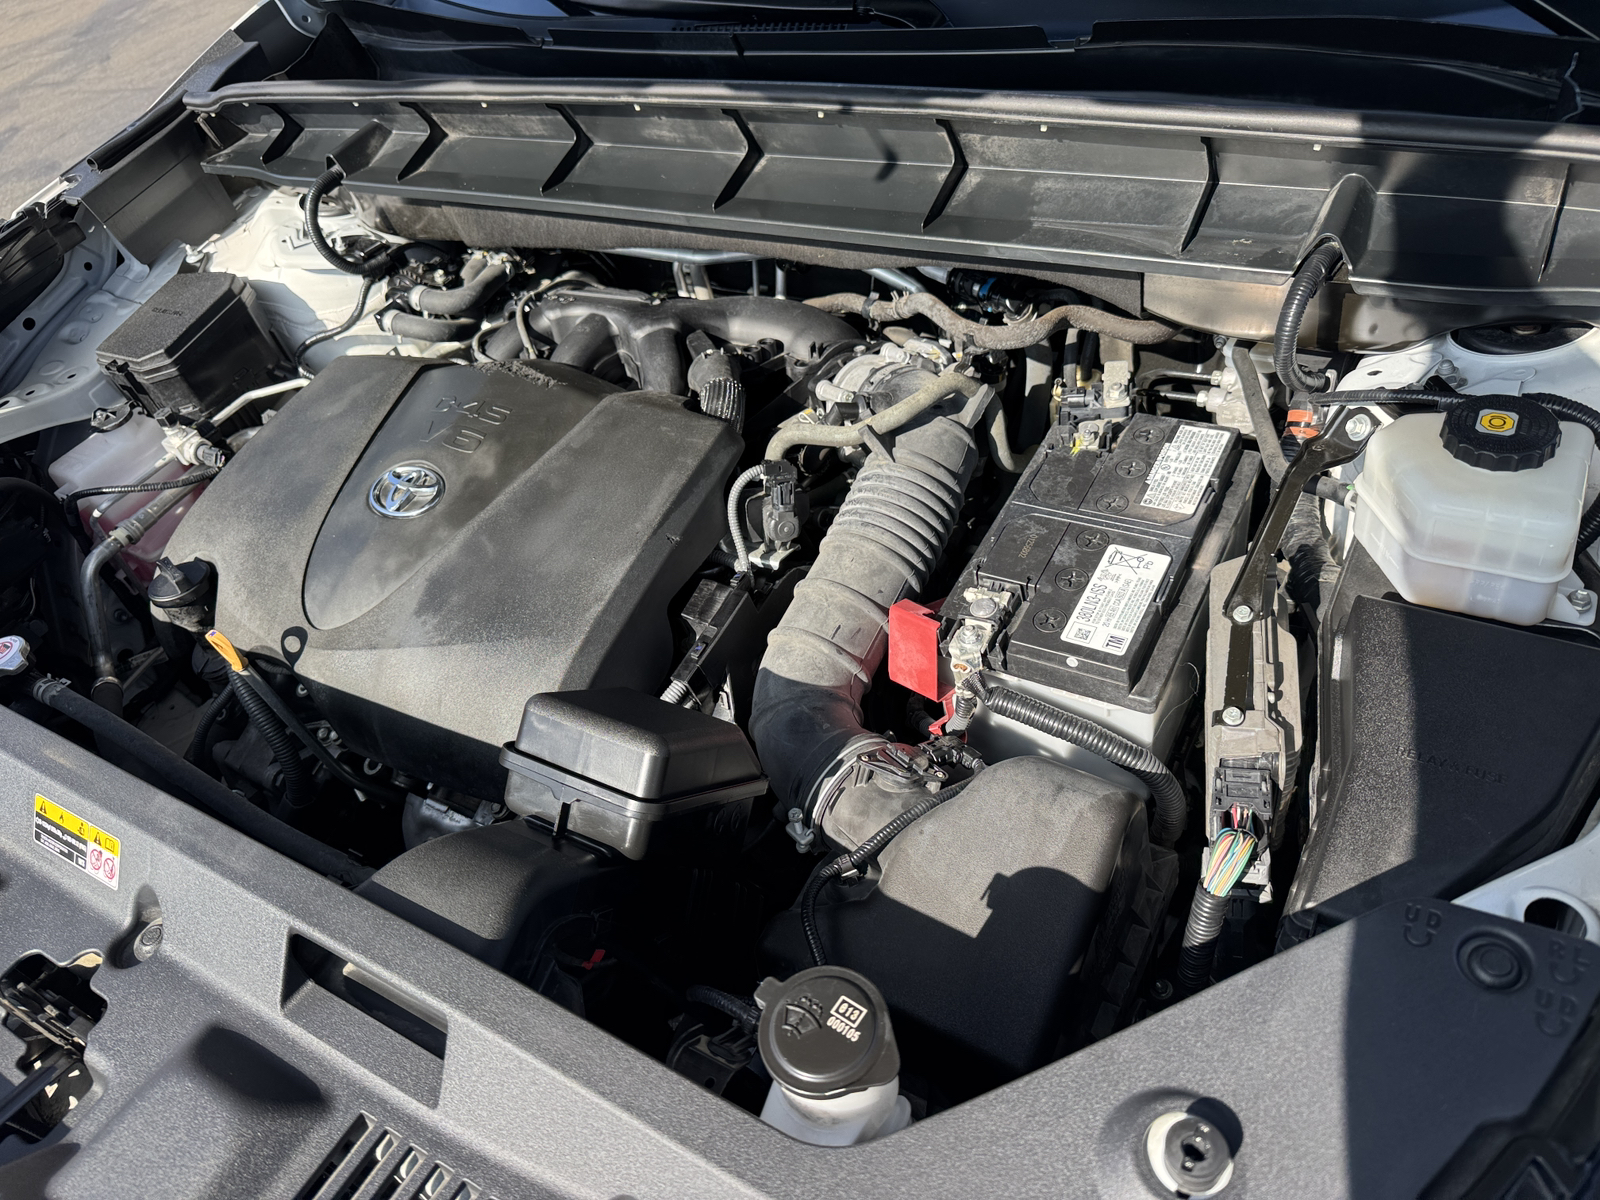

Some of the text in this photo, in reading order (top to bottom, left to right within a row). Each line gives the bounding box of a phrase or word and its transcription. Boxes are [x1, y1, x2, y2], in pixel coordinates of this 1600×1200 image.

[420, 420, 488, 454] V6
[1142, 560, 1154, 570] Pb
[1105, 635, 1126, 649] TM
[1396, 745, 1448, 769] RELAY
[1465, 765, 1508, 787] FUSE
[826, 1016, 861, 1042] 000105
